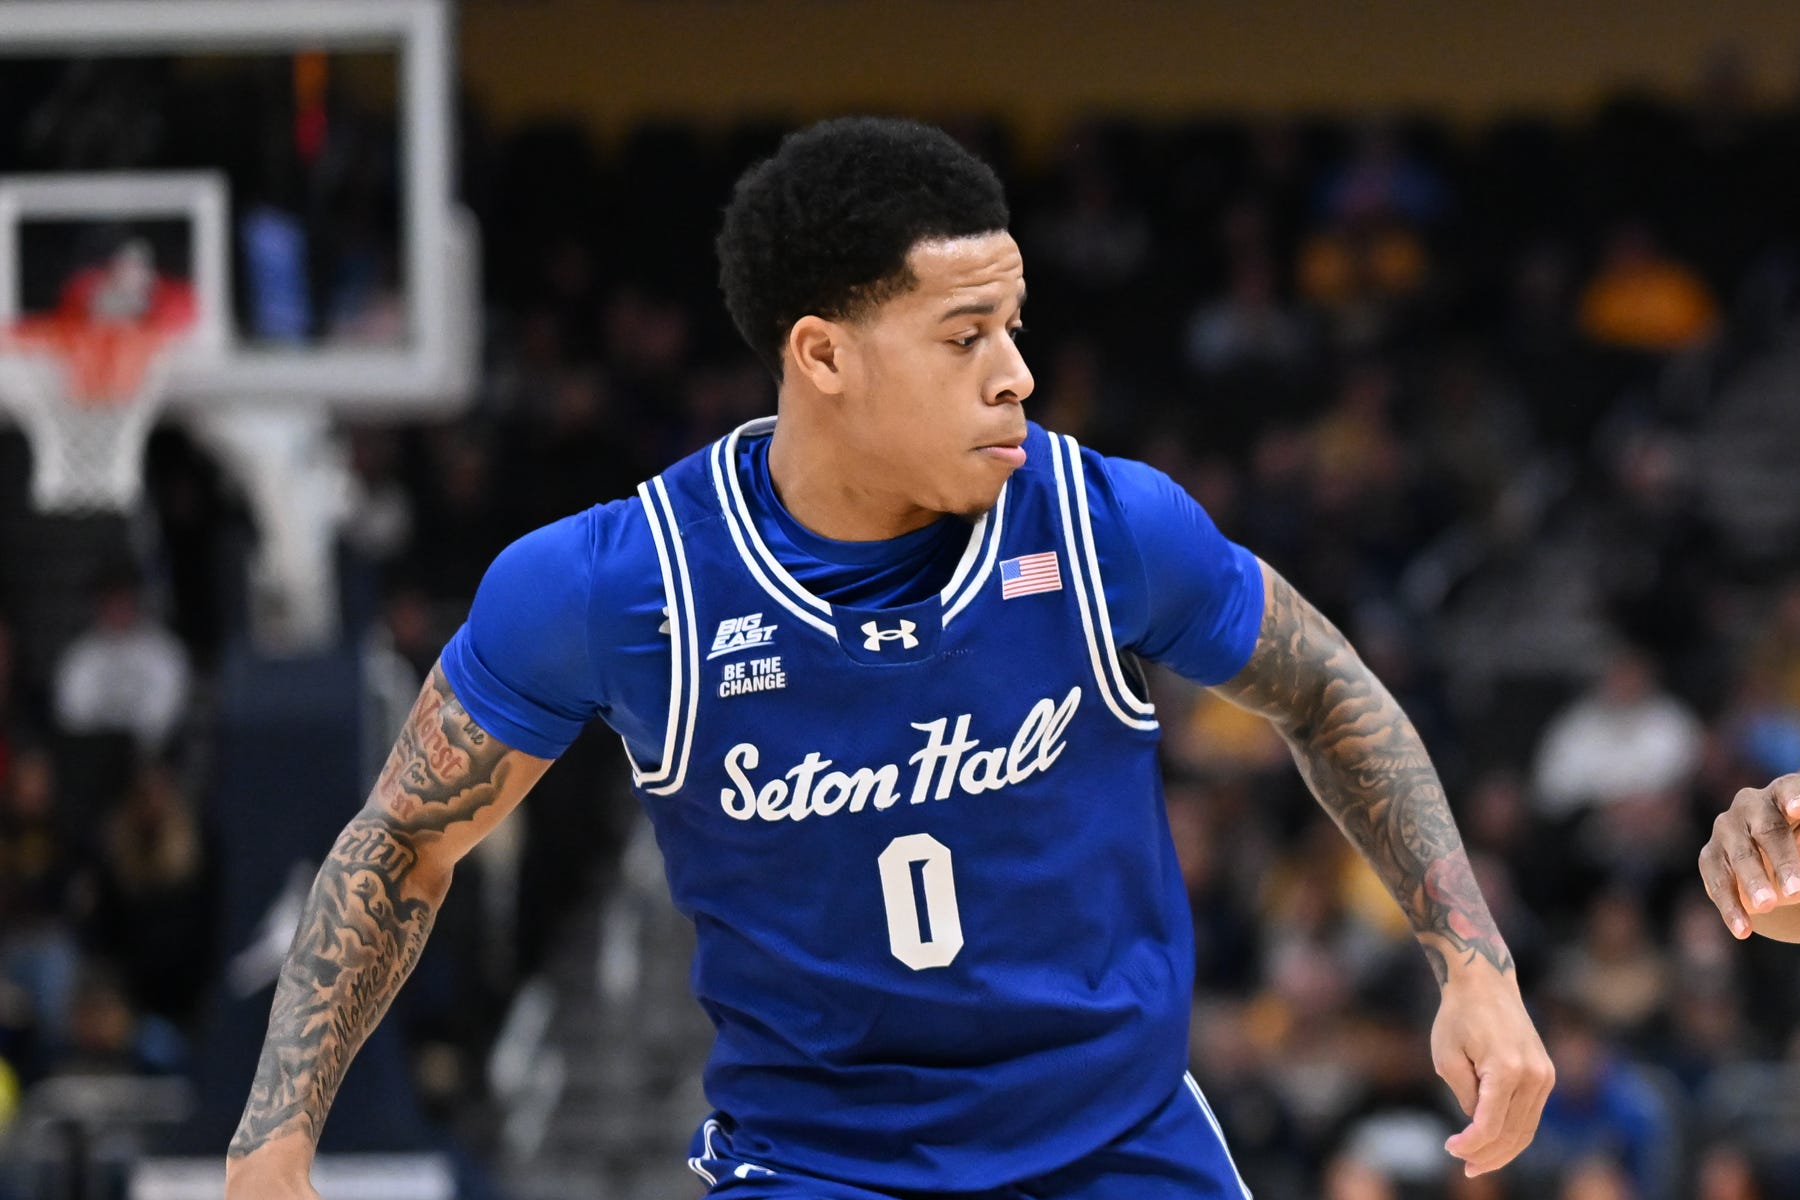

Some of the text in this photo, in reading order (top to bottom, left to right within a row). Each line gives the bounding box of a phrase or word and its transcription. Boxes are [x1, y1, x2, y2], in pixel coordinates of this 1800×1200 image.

[716, 612, 763, 636] BIG
[711, 624, 778, 651] EAST
[724, 656, 781, 681] BE THE
[719, 672, 786, 698] CHANGE
[720, 686, 1083, 822] Seton Hall
[877, 833, 964, 971] 0
